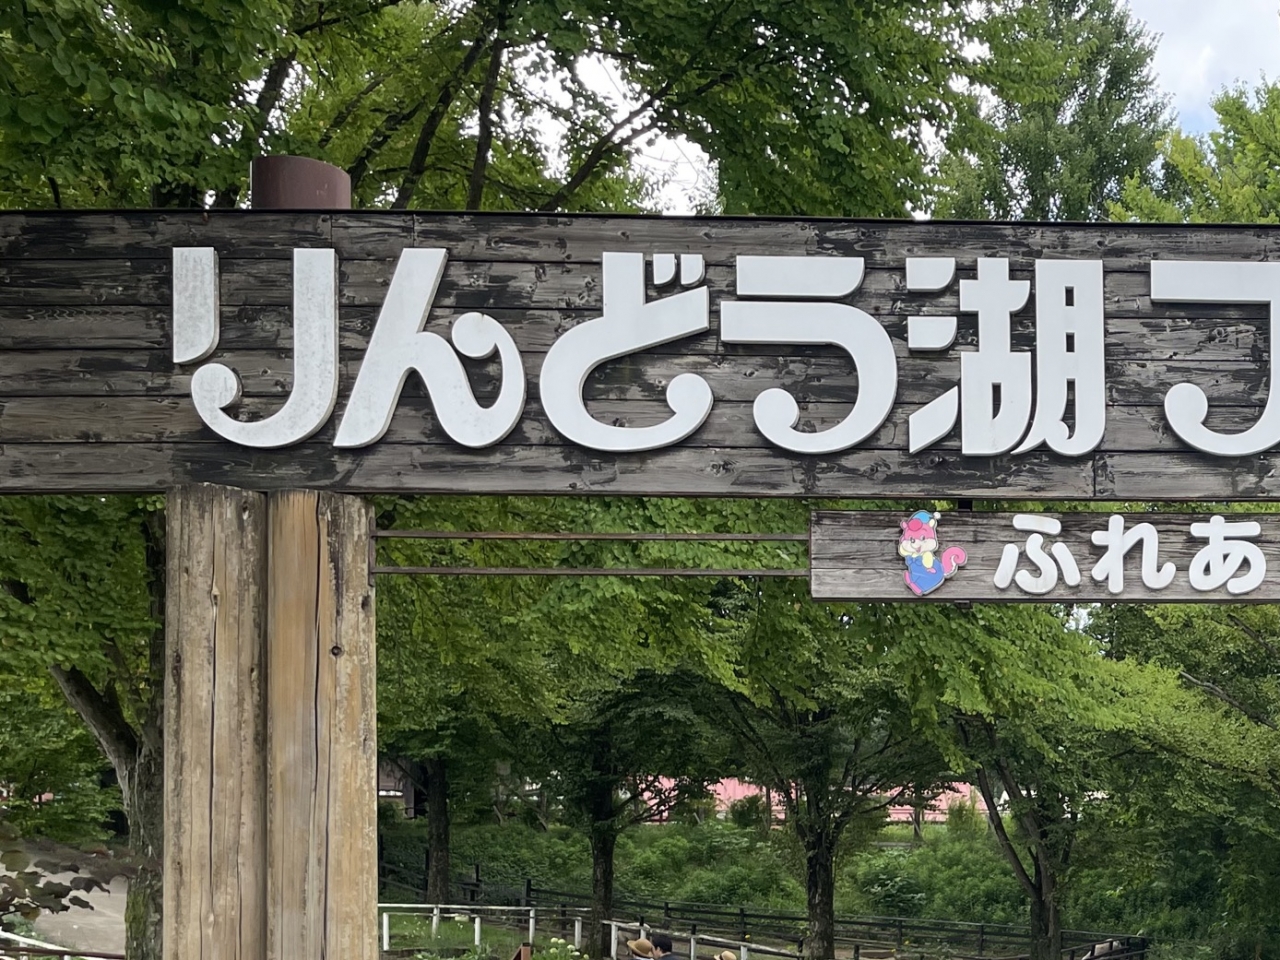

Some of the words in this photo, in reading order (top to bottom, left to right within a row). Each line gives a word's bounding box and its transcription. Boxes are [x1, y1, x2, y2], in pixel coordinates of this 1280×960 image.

[171, 247, 1106, 456] りんどう湖
